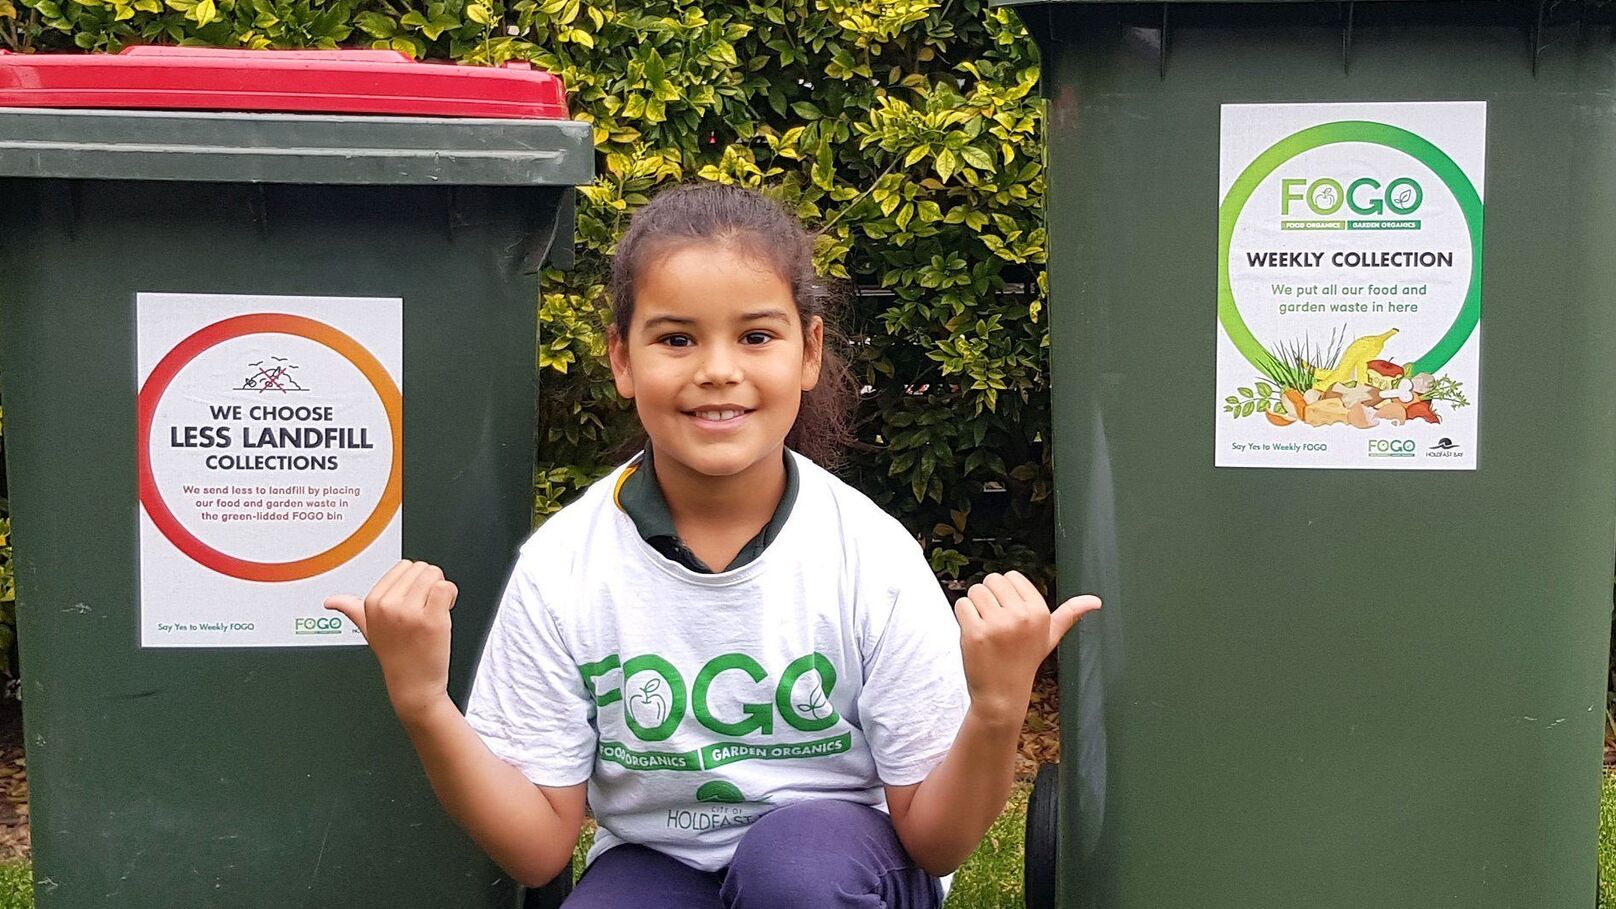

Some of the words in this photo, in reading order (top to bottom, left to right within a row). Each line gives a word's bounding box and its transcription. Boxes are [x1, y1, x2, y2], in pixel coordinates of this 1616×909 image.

[1281, 178, 1423, 215] FOGO
[1247, 252, 1324, 267] WEEKLY
[1331, 252, 1453, 267] COLLECTION
[1272, 284, 1292, 295] We
[1297, 285, 1317, 298] put
[1322, 284, 1337, 295] all
[1342, 286, 1363, 295] our
[1368, 284, 1398, 295] food
[1402, 284, 1427, 295] and
[1279, 302, 1326, 314] garden
[1330, 303, 1368, 312] waste
[1372, 302, 1383, 312] in
[1388, 302, 1418, 312] here
[210, 405, 241, 420] WE
[250, 406, 333, 421] CHOOSE
[170, 426, 232, 448] LESS
[243, 428, 373, 449] LANDFILL
[1232, 442, 1246, 452] Say
[1273, 443, 1301, 452] Weekly
[1368, 440, 1416, 452] FOGO
[206, 455, 338, 470] COLLECTIONS
[183, 485, 200, 494] We
[203, 486, 228, 494] send
[232, 486, 252, 494] less
[256, 486, 266, 494] to
[269, 486, 304, 494] landfill
[308, 486, 320, 496] by
[323, 486, 360, 496] placing
[217, 499, 240, 508] food
[244, 499, 263, 508] and
[266, 499, 303, 509] garden
[339, 499, 348, 508] in
[202, 512, 219, 520] the
[222, 512, 289, 522] green-lidded
[292, 512, 324, 520] FOGO
[327, 512, 342, 520] bin
[158, 623, 172, 632] Say
[200, 623, 228, 632] Weekly
[296, 618, 342, 630] FOGO
[578, 652, 840, 741] FOGO
[712, 747, 766, 762] GARDEN
[772, 740, 842, 757] ORGANICS
[626, 753, 686, 767] ORGANICS
[667, 809, 752, 830] HOLDFAST
